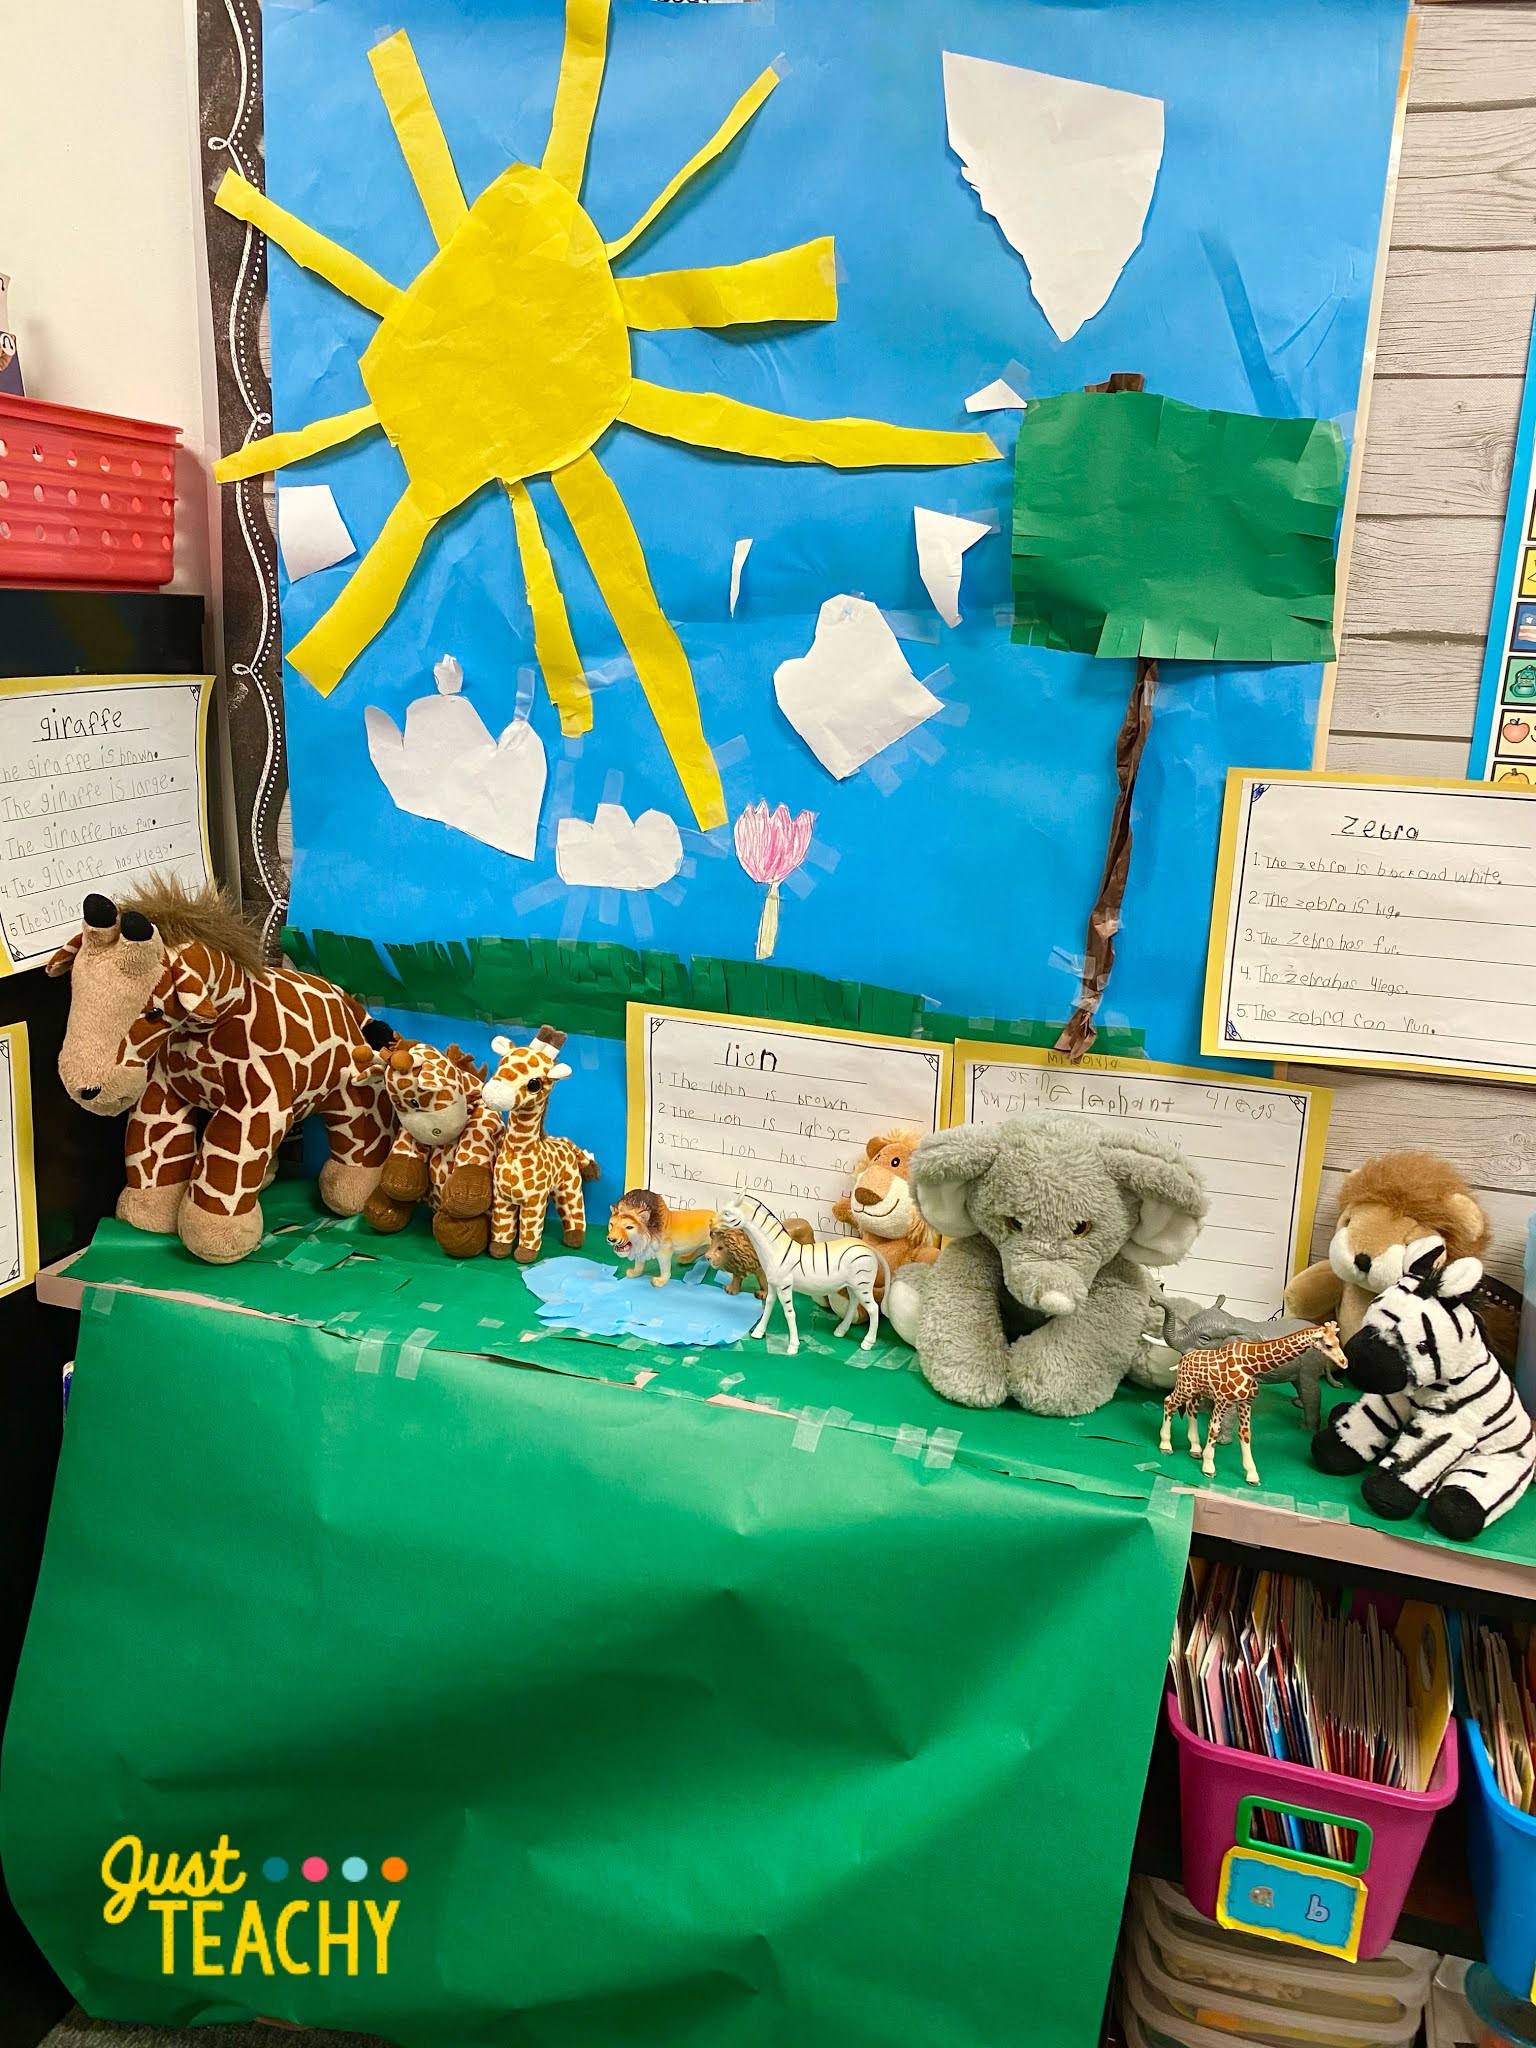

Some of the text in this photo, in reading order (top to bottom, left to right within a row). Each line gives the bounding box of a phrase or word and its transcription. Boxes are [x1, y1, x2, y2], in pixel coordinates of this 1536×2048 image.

[40, 708, 123, 740] giraffe
[0, 765, 20, 780] he
[29, 753, 92, 777] giraffe
[100, 745, 115, 767] is
[1, 796, 34, 819] The
[41, 783, 102, 812] giraffe
[109, 776, 125, 801] is
[5, 837, 35, 859] The
[43, 822, 103, 849] giraffe
[109, 822, 128, 837] has
[11, 877, 35, 895] The
[41, 855, 104, 888] giraffe
[114, 855, 132, 868] has
[1262, 855, 1287, 868] The
[1355, 858, 1369, 875] is
[1262, 891, 1289, 907] The
[1256, 931, 1278, 944] The
[1254, 964, 1279, 983] The
[1252, 1004, 1277, 1020] The
[1353, 1013, 1386, 1030] can
[725, 1042, 778, 1072] lion
[670, 1072, 698, 1090] The
[765, 1088, 777, 1101] is
[670, 1105, 695, 1119] The
[713, 1113, 741, 1126] lion
[762, 1117, 776, 1132] is
[668, 1133, 699, 1150] The
[722, 1137, 756, 1158] lion
[779, 1148, 807, 1166] has
[669, 1162, 702, 1181] The
[735, 1170, 773, 1191] lion
[790, 1181, 821, 1199] has
[664, 1194, 697, 1211] The
[1305, 1894, 1330, 1922] b
